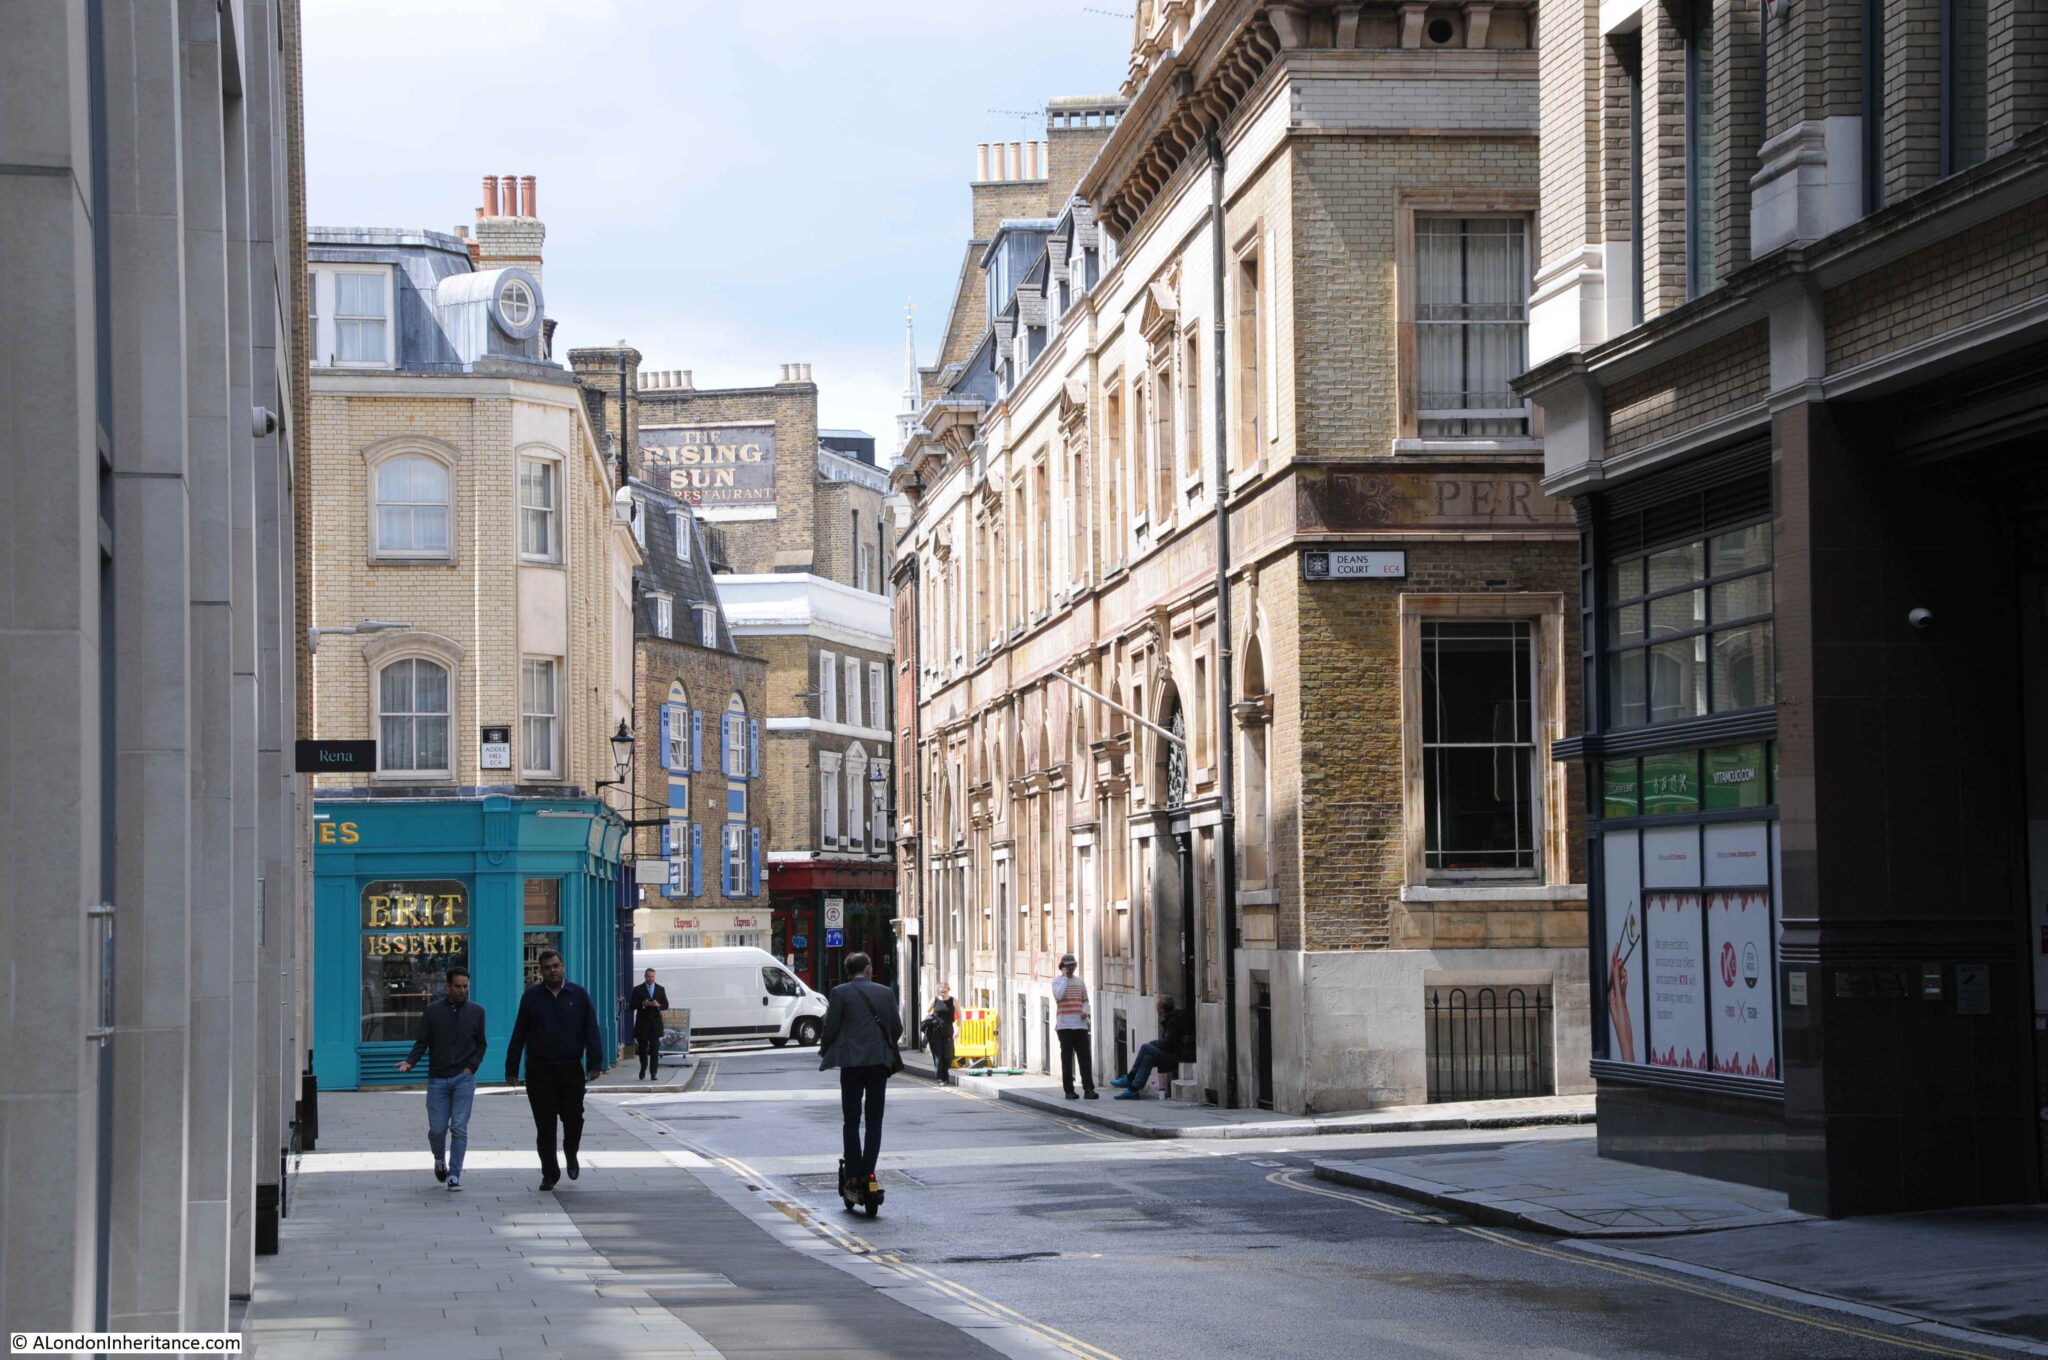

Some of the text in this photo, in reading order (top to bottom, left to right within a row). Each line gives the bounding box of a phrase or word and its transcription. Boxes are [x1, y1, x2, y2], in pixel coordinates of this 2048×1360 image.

[681, 430, 721, 444] THE
[643, 443, 763, 466] RISING
[670, 468, 736, 489] SUN
[1434, 480, 1539, 522] PER
[1337, 555, 1369, 564] DEANS
[1337, 565, 1400, 574] COURT EC4
[319, 749, 353, 762] Rena
[311, 821, 360, 845] ES
[368, 894, 463, 927] BRIT
[368, 934, 463, 956] ISSERIE
